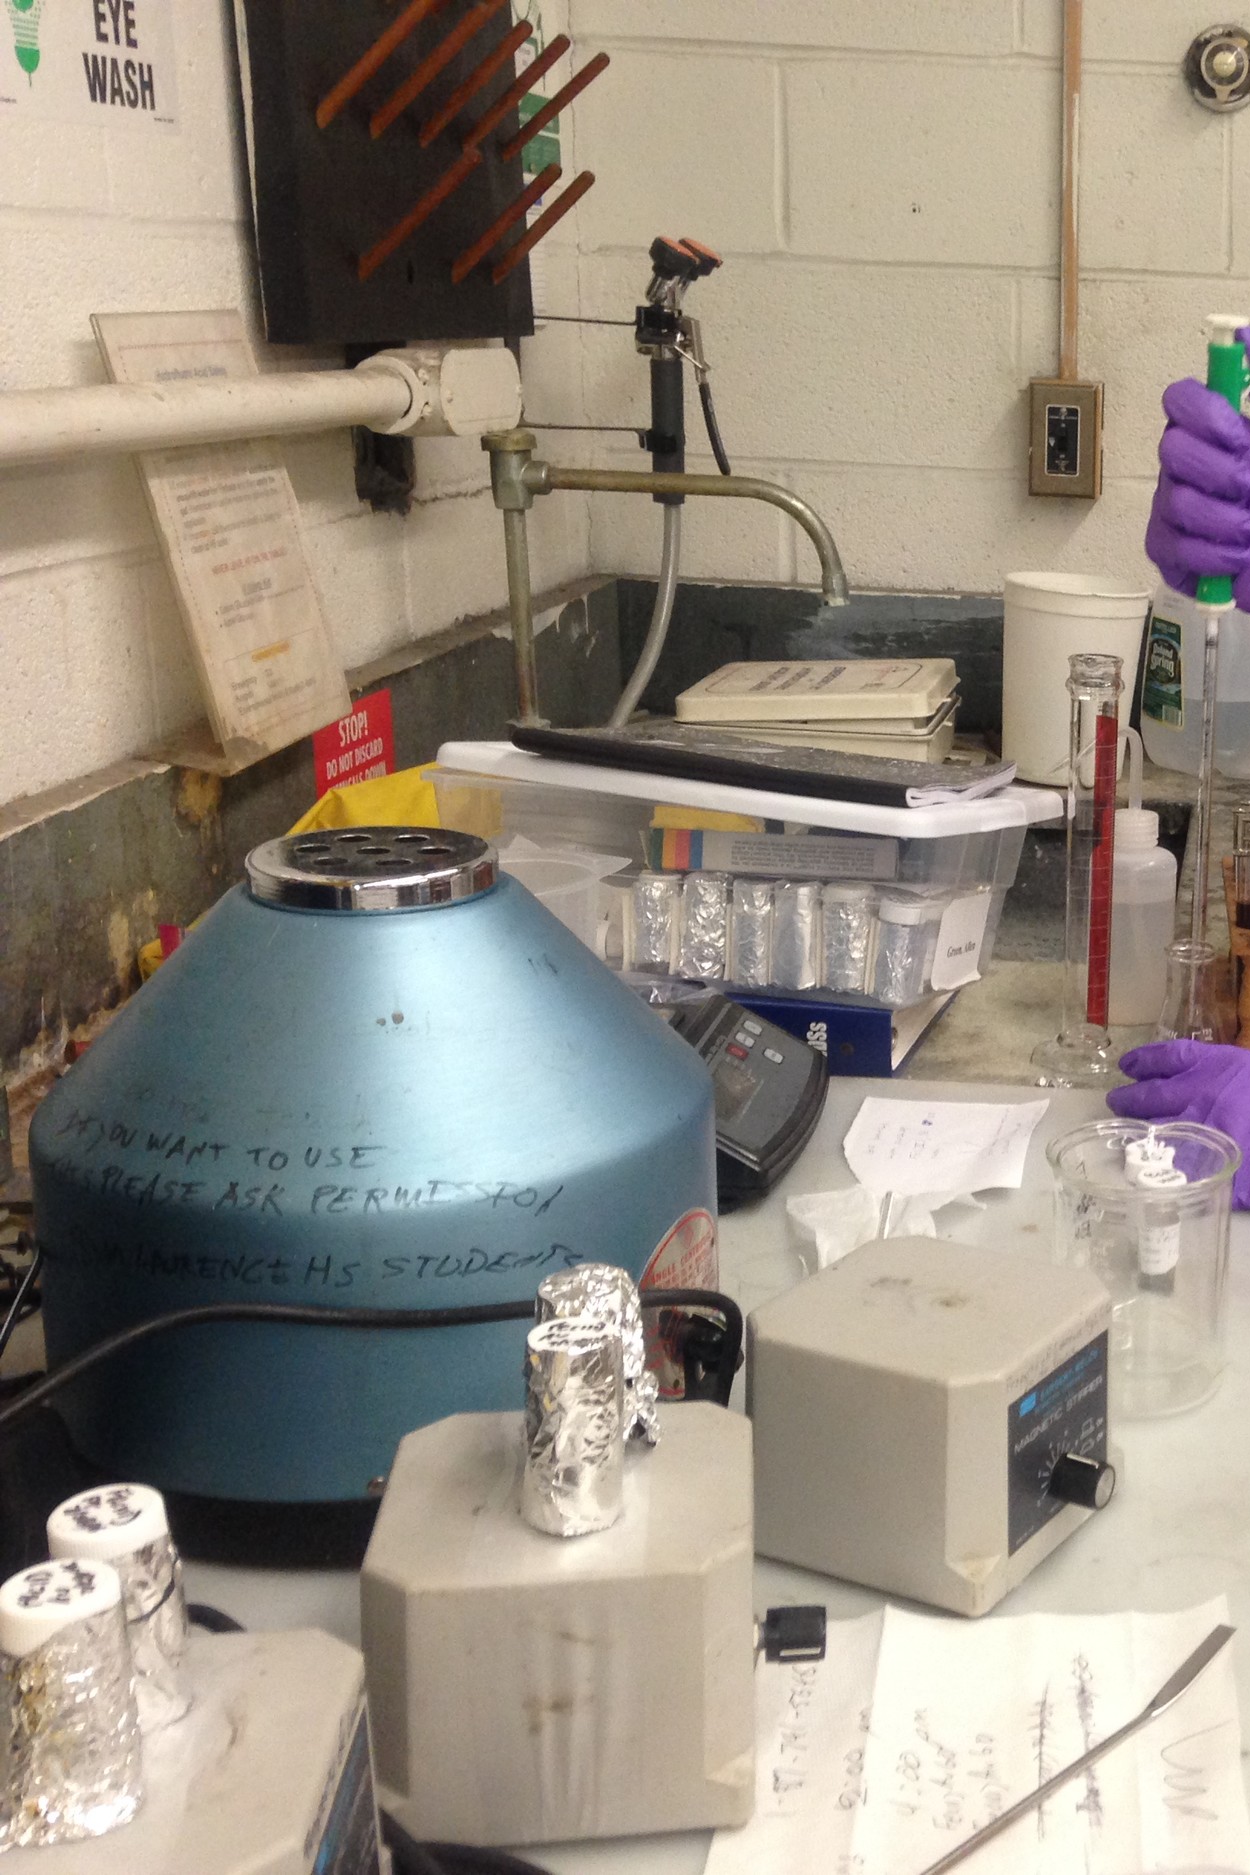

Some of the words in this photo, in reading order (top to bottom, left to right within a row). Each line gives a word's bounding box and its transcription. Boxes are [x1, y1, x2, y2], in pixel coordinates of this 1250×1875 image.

[93, 0, 138, 49] EYE
[82, 52, 156, 111] WASH
[338, 710, 369, 748] STOP!
[326, 759, 338, 780] DO
[338, 751, 354, 774] NOT
[354, 737, 384, 766] DISCARD
[146, 1132, 230, 1166] WANT
[246, 1146, 289, 1171] TO
[304, 1145, 386, 1169] USE
[100, 1165, 206, 1209] PLEASE
[210, 1181, 286, 1217] ASK
[304, 1254, 361, 1288] HS
